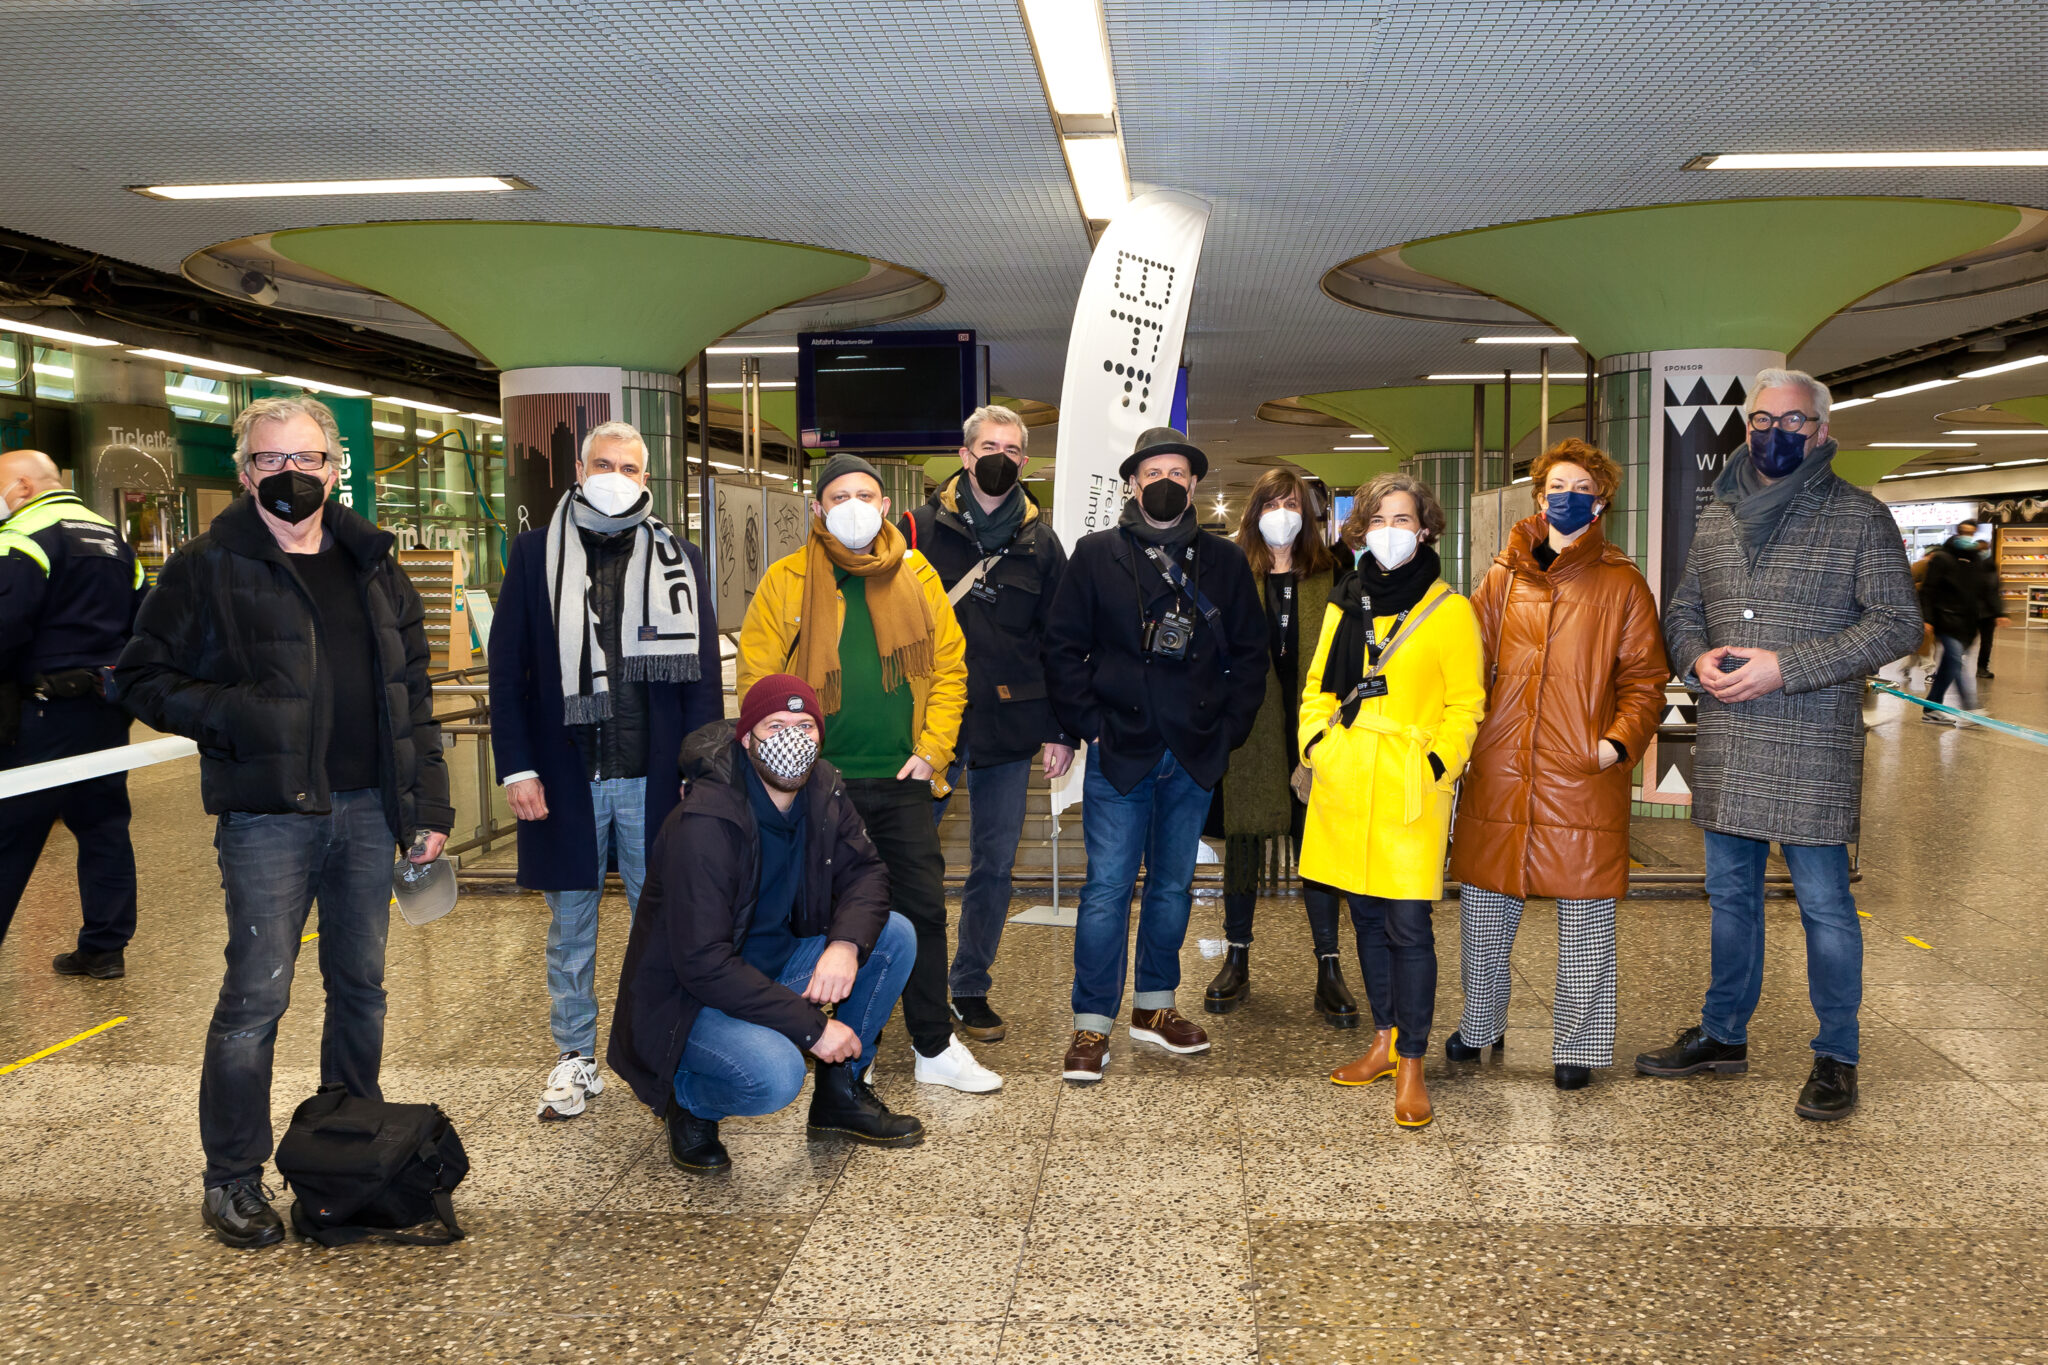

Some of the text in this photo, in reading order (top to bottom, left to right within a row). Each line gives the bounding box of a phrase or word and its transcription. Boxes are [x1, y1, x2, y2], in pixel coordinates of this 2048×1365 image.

[1102, 249, 1176, 415] BFF
[811, 338, 835, 346] Abfahrt
[1664, 364, 1703, 372] SPONSOR
[1102, 478, 1118, 526] Freie
[1144, 547, 1158, 560] BFF
[1283, 586, 1292, 600] BFF
[1361, 595, 1371, 611] BFF
[1280, 614, 1289, 628] BFF
[1365, 629, 1375, 646] BFF
